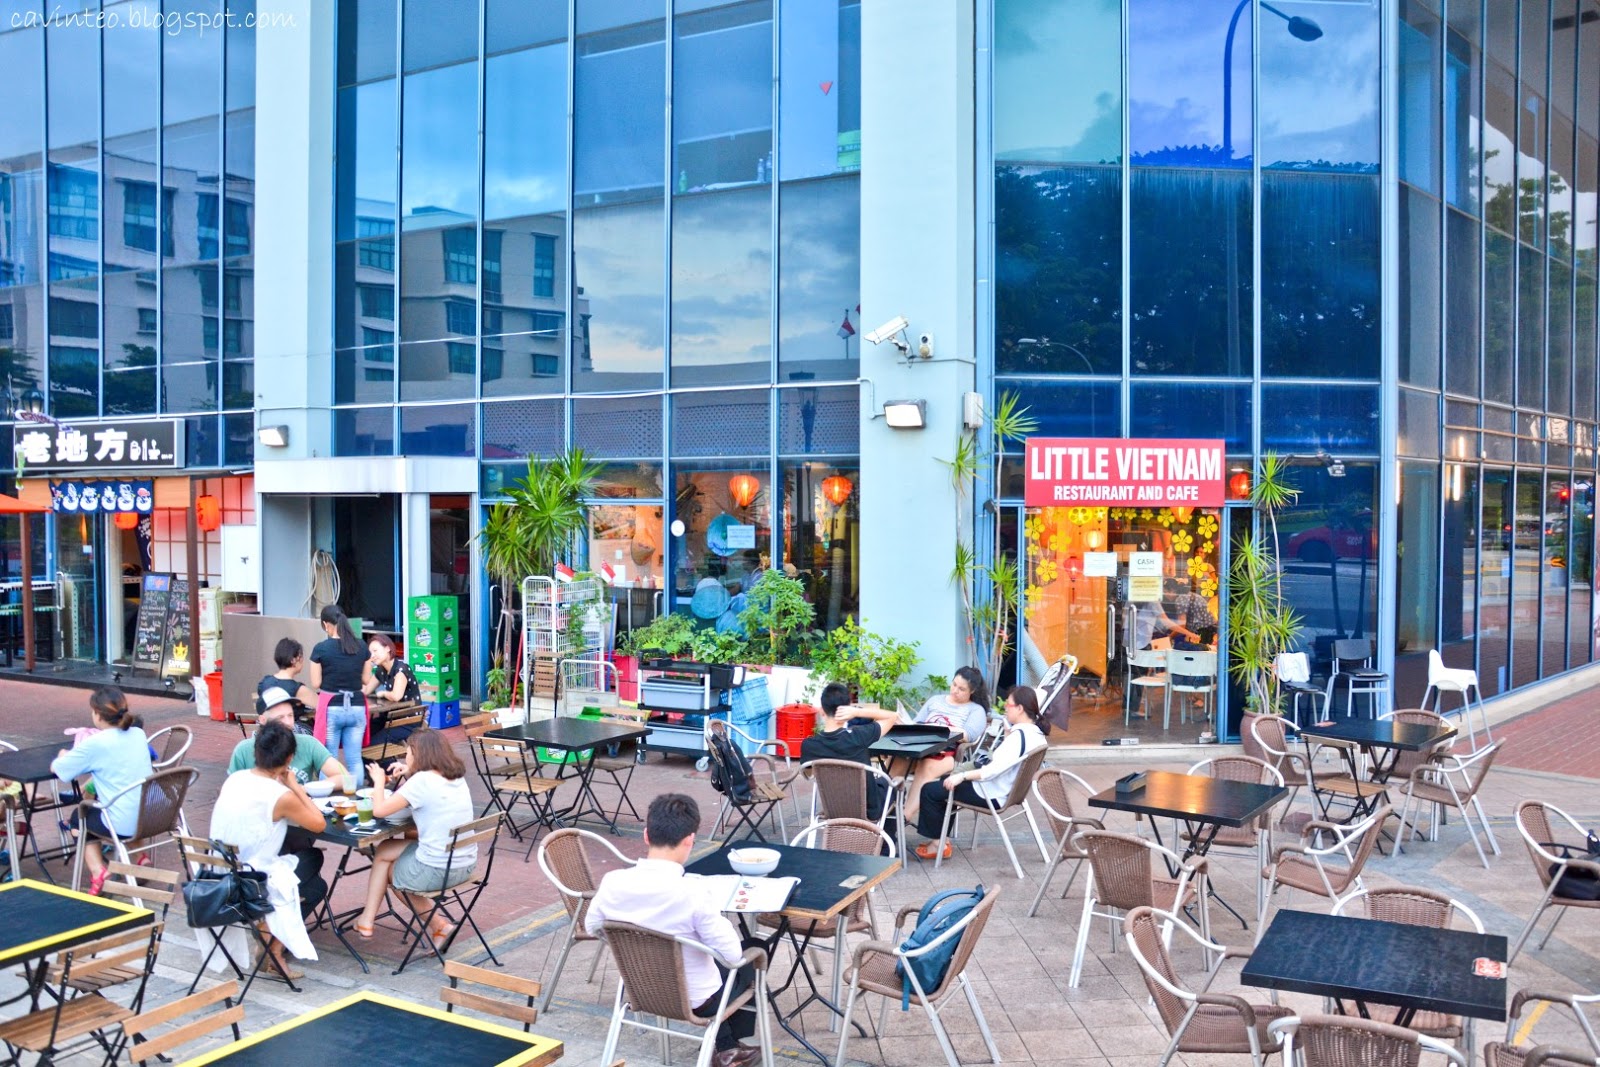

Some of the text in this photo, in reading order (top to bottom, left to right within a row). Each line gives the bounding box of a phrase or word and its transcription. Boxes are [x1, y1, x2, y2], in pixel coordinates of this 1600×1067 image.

[20, 428, 128, 463] 老地方
[1031, 447, 1221, 480] LITTLE VIETNAM
[1054, 485, 1199, 501] RESTAURANT AND CAFE
